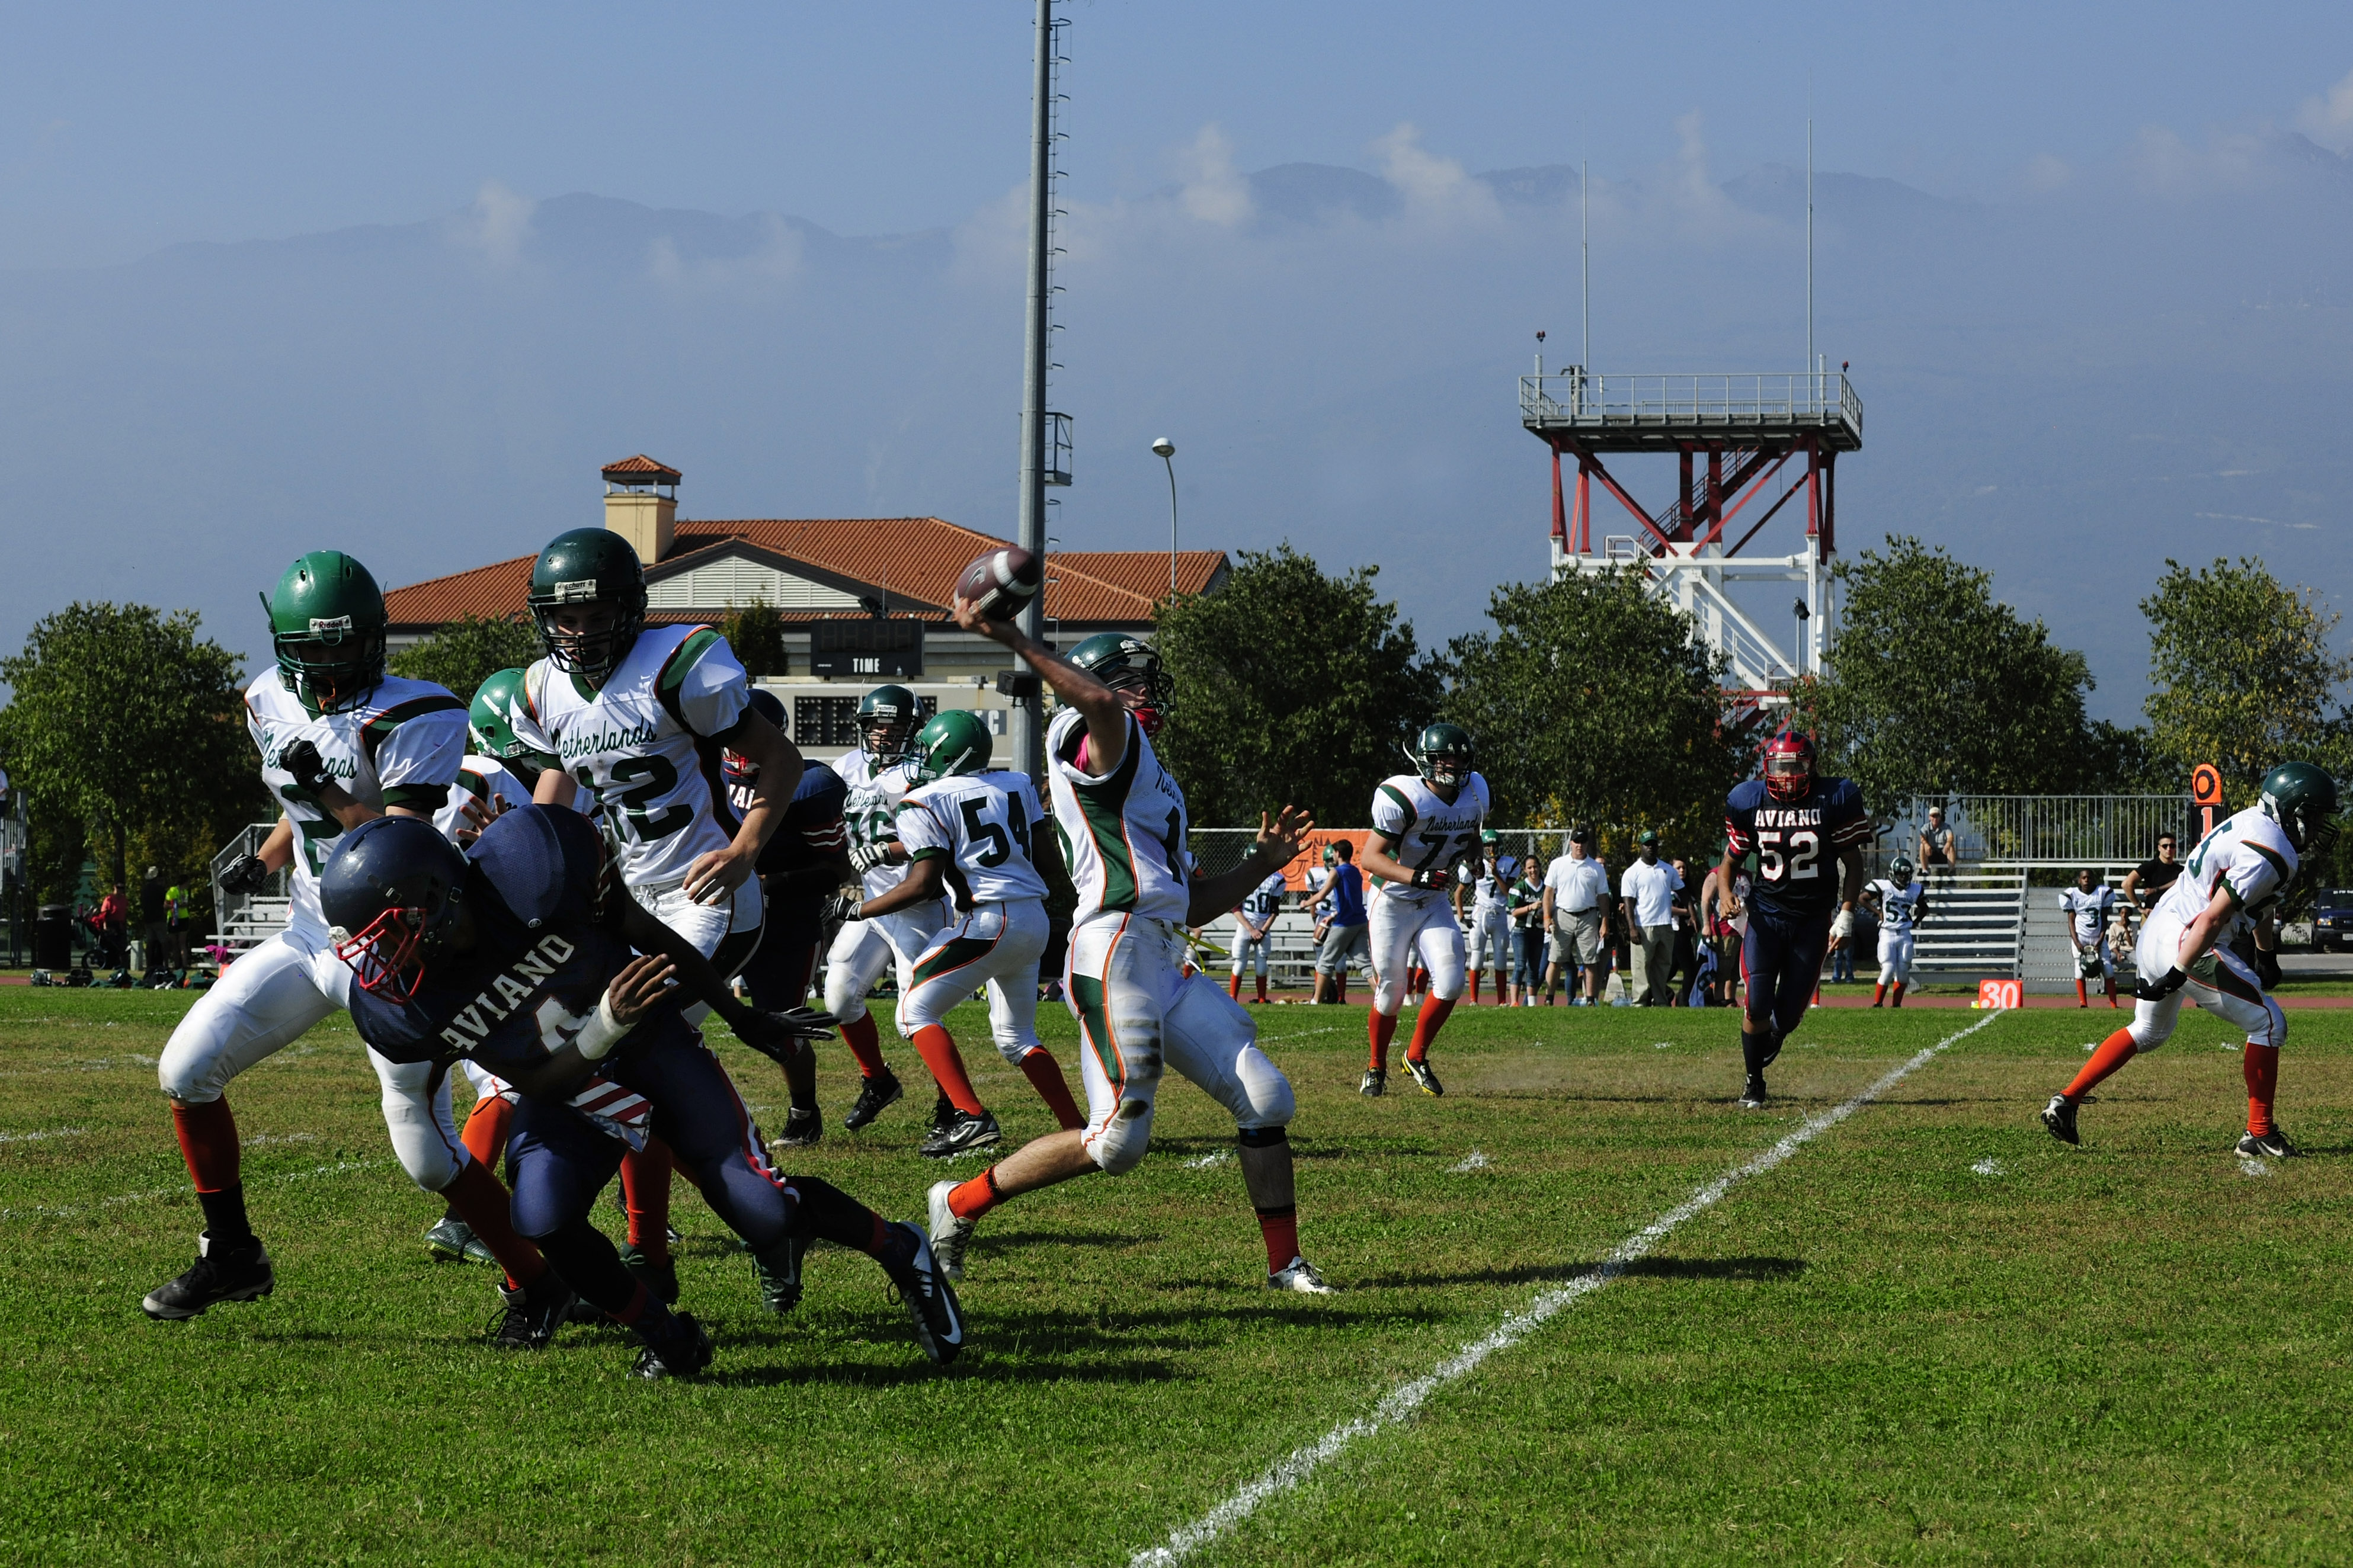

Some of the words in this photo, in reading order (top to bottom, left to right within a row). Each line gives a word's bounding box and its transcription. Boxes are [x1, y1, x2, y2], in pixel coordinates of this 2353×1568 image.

[853, 658, 880, 673] TIME
[549, 714, 657, 759] Netherlands
[576, 755, 694, 842] 12
[1754, 808, 1821, 828] AVIANO
[846, 811, 903, 865] 76
[959, 791, 1031, 868] 54
[1756, 831, 1819, 881] 52
[2085, 908, 2099, 928] 3
[439, 934, 575, 1052] AVIANO
[1980, 982, 2018, 1009] 30
